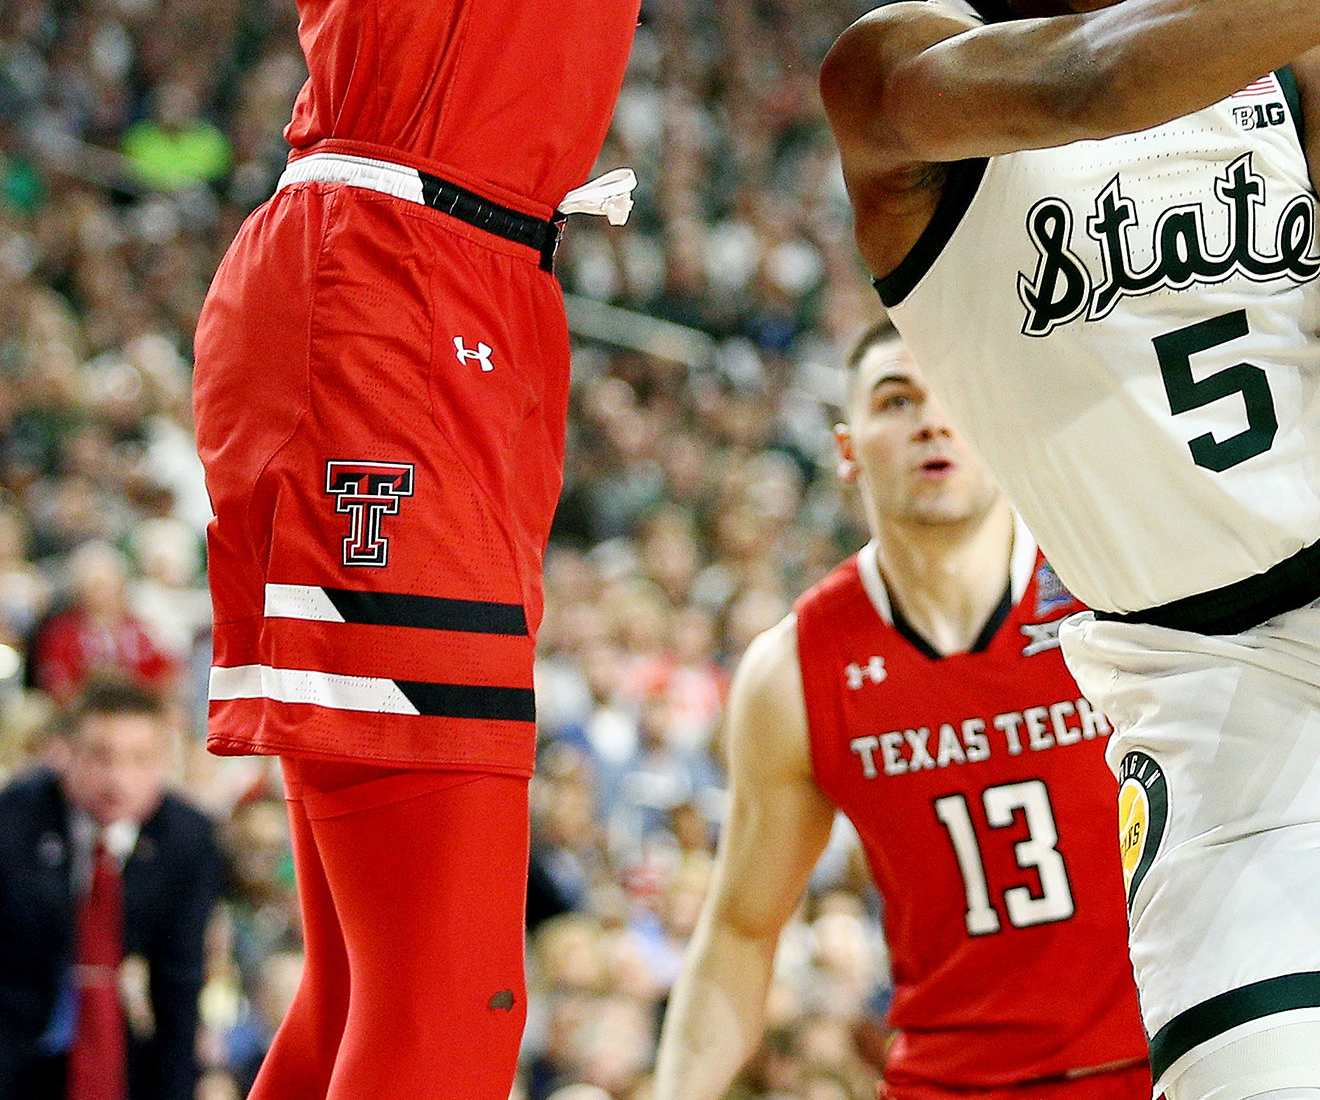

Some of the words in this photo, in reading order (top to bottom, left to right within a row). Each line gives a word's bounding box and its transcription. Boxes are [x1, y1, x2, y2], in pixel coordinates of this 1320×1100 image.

[1151, 308, 1279, 474] 5
[850, 717, 993, 780] TEXAS
[992, 696, 1112, 756] TECH
[933, 778, 1076, 937] 13
